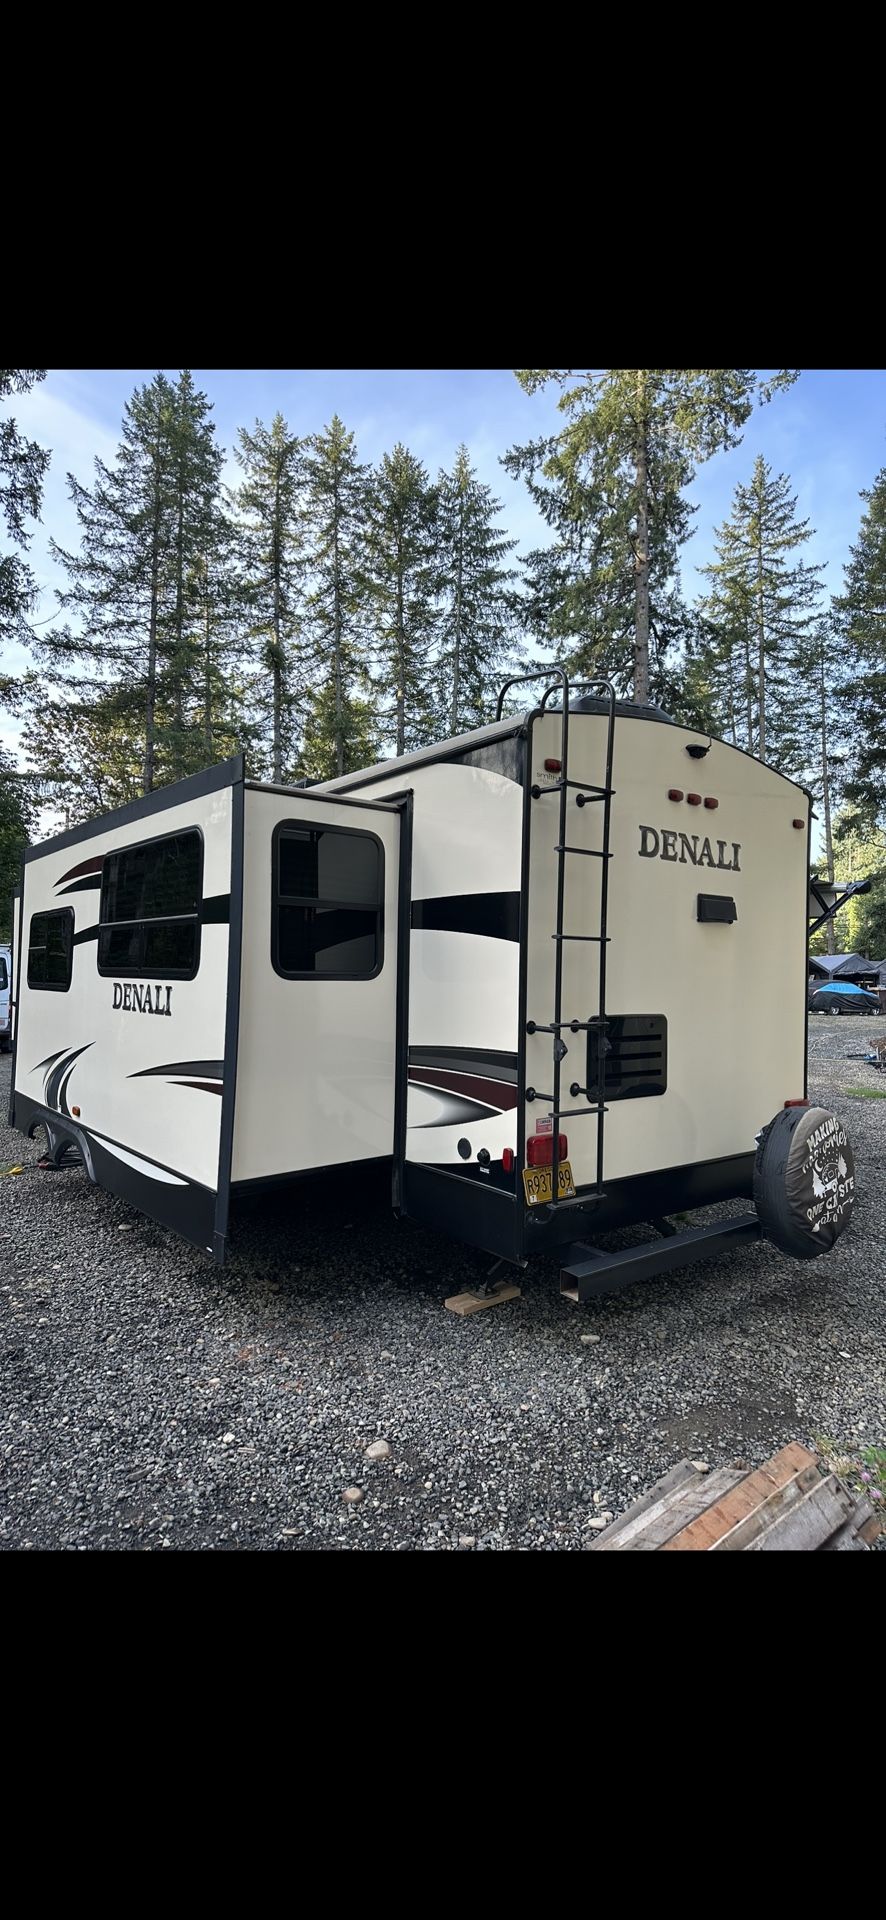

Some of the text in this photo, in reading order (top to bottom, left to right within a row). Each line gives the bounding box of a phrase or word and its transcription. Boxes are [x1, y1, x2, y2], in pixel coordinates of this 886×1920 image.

[638, 825, 742, 872] DENALI
[112, 982, 173, 1017] DENALI
[806, 1117, 840, 1152] MAKING
[527, 1169, 571, 1194] R93789
